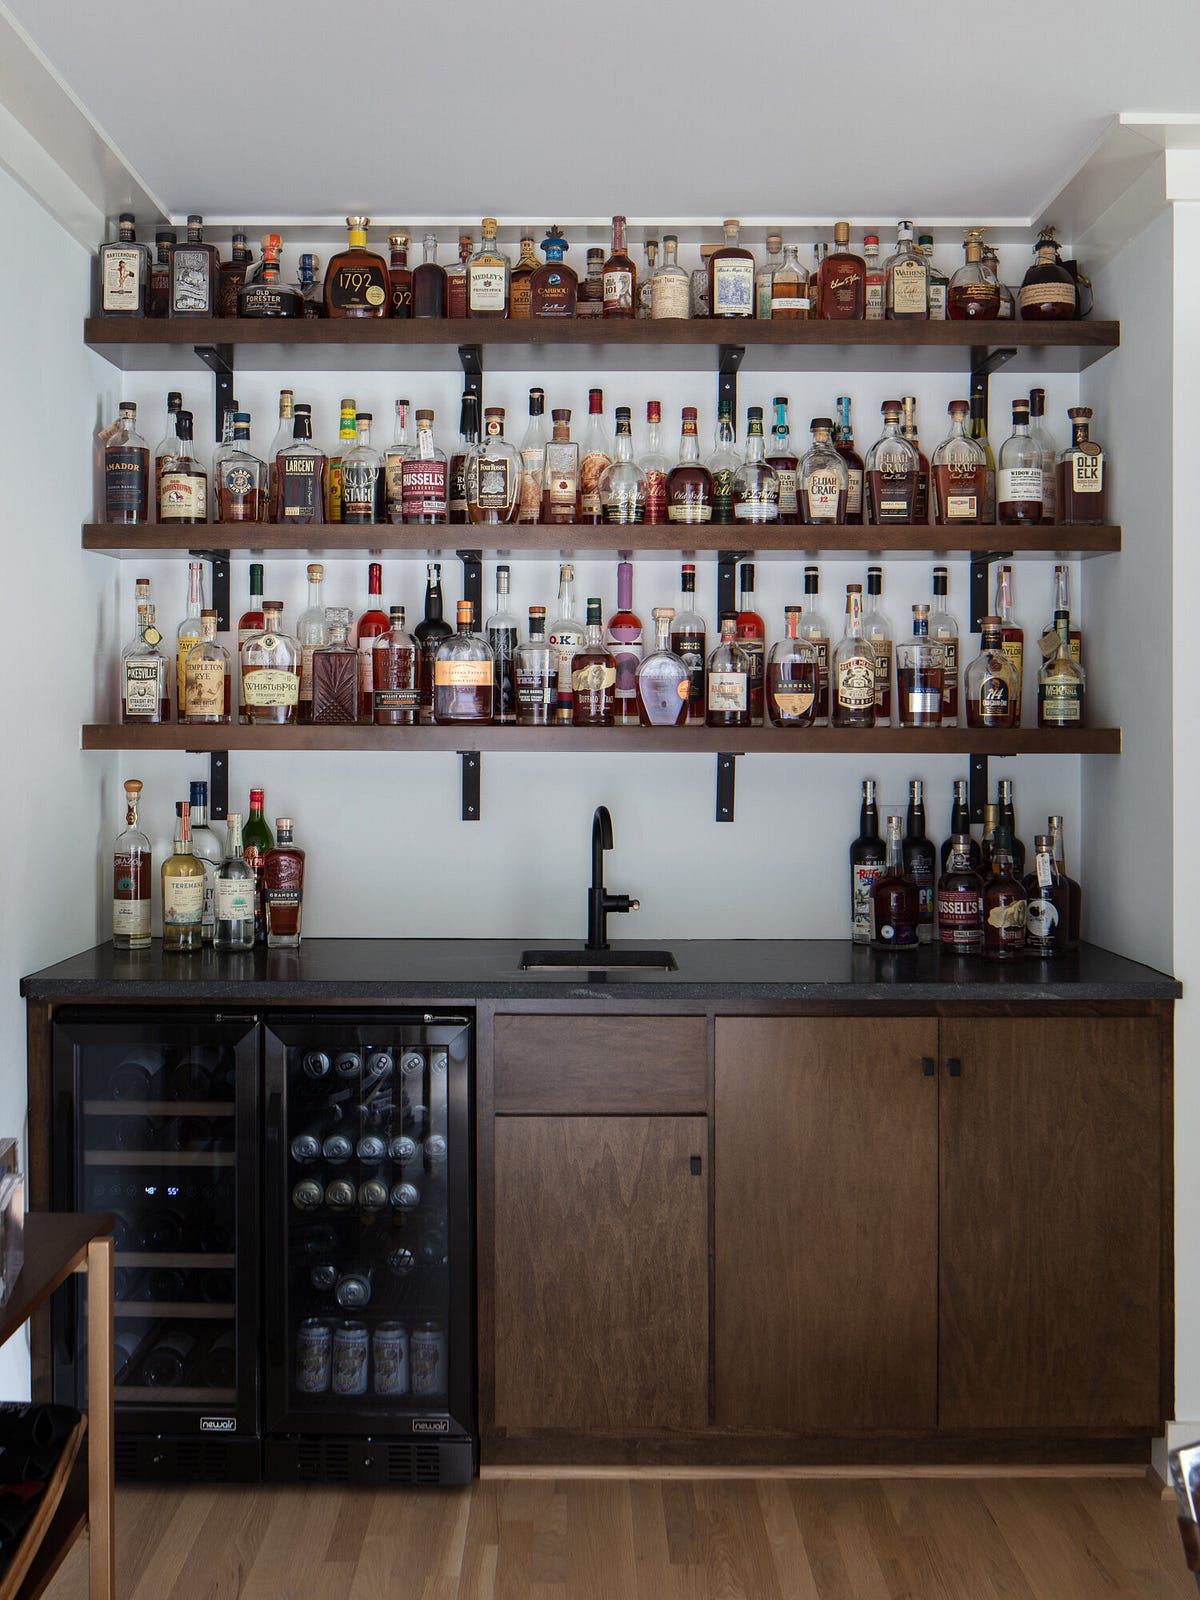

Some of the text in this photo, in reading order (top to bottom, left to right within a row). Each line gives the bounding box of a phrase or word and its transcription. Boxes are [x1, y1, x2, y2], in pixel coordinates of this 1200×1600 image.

[340, 274, 372, 292] 1792
[605, 286, 617, 294] 101
[880, 453, 908, 463] ELIJAH
[1077, 457, 1098, 468] OLD
[286, 460, 315, 472] LARCENY
[880, 463, 908, 474] CRAIG
[948, 462, 976, 473] CRAIG
[230, 469, 251, 478] BLADE
[1077, 468, 1098, 479] ELK
[403, 473, 444, 486] RUSSELL'S
[812, 476, 837, 486] ELIJAH
[811, 486, 837, 496] CRAIG
[128, 668, 157, 678] PIKESVILLE
[246, 682, 297, 693] WHISTLEPIG
[203, 1420, 234, 1429] newair
[415, 1422, 446, 1430] newair
